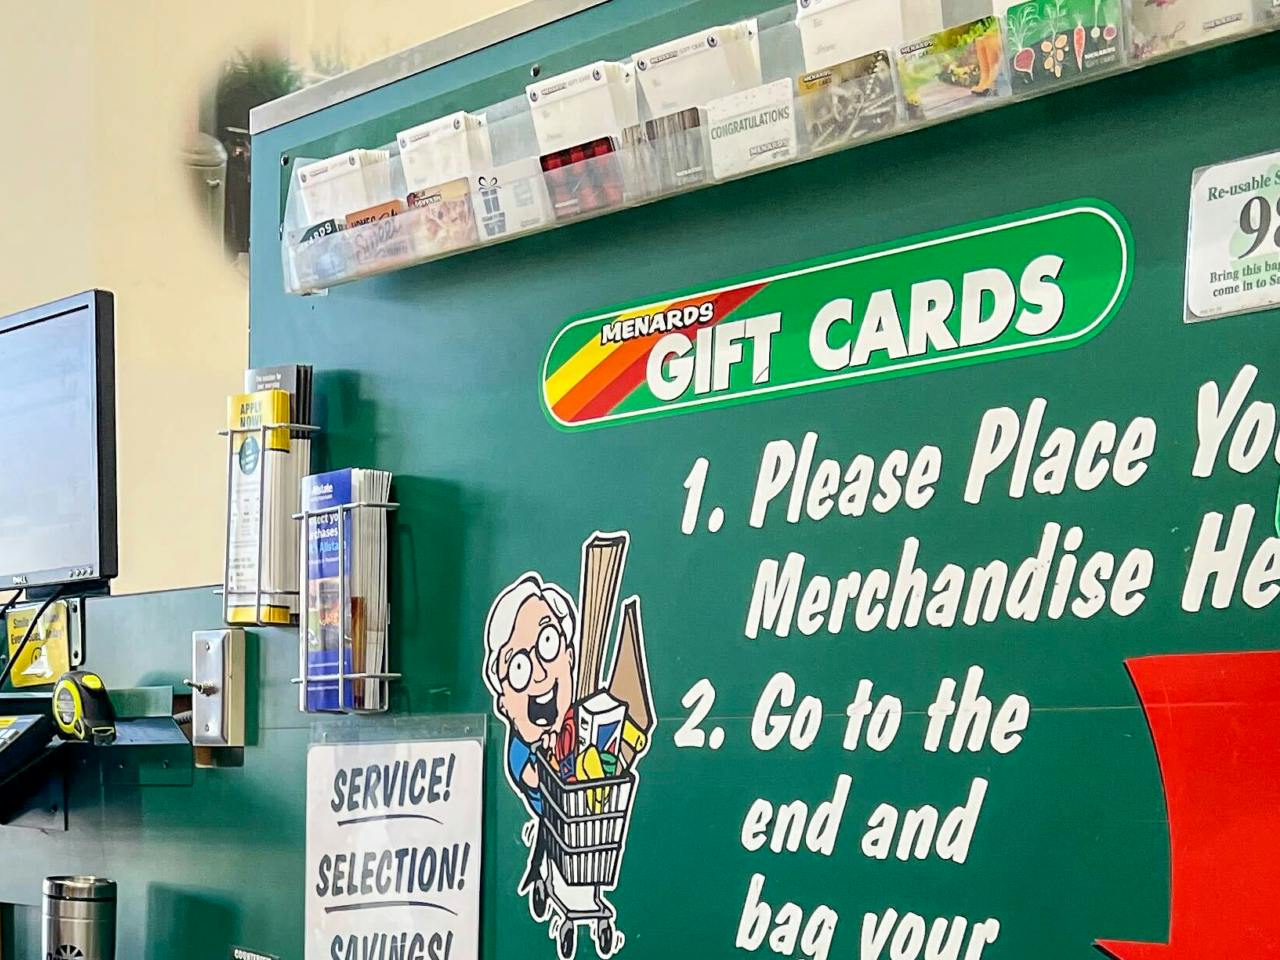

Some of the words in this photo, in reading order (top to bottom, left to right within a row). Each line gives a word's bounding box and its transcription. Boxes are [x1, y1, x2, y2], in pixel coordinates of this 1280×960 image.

[710, 105, 790, 141] CONGRATULATIONS
[1207, 174, 1271, 202] Re-usable
[1209, 269, 1239, 284] Bring
[1242, 263, 1262, 278] this
[1212, 283, 1240, 298] come
[1242, 279, 1253, 292] in
[1255, 277, 1267, 289] to
[600, 302, 714, 346] MENARDS
[645, 311, 782, 401] GIFT
[808, 254, 1065, 372] CARDS
[681, 457, 725, 535] 1.
[749, 431, 942, 528] Please
[963, 397, 1157, 504] Place
[1191, 364, 1280, 478] Yo
[744, 521, 1154, 640] Merchandise
[1181, 503, 1280, 613] He
[673, 678, 725, 750] 2.
[750, 671, 823, 751] Go
[842, 678, 902, 752] to
[923, 665, 1030, 754] the
[330, 752, 457, 813] SERVICE!
[741, 773, 853, 856] end
[861, 777, 989, 864] and
[315, 841, 471, 897] SELECTION!
